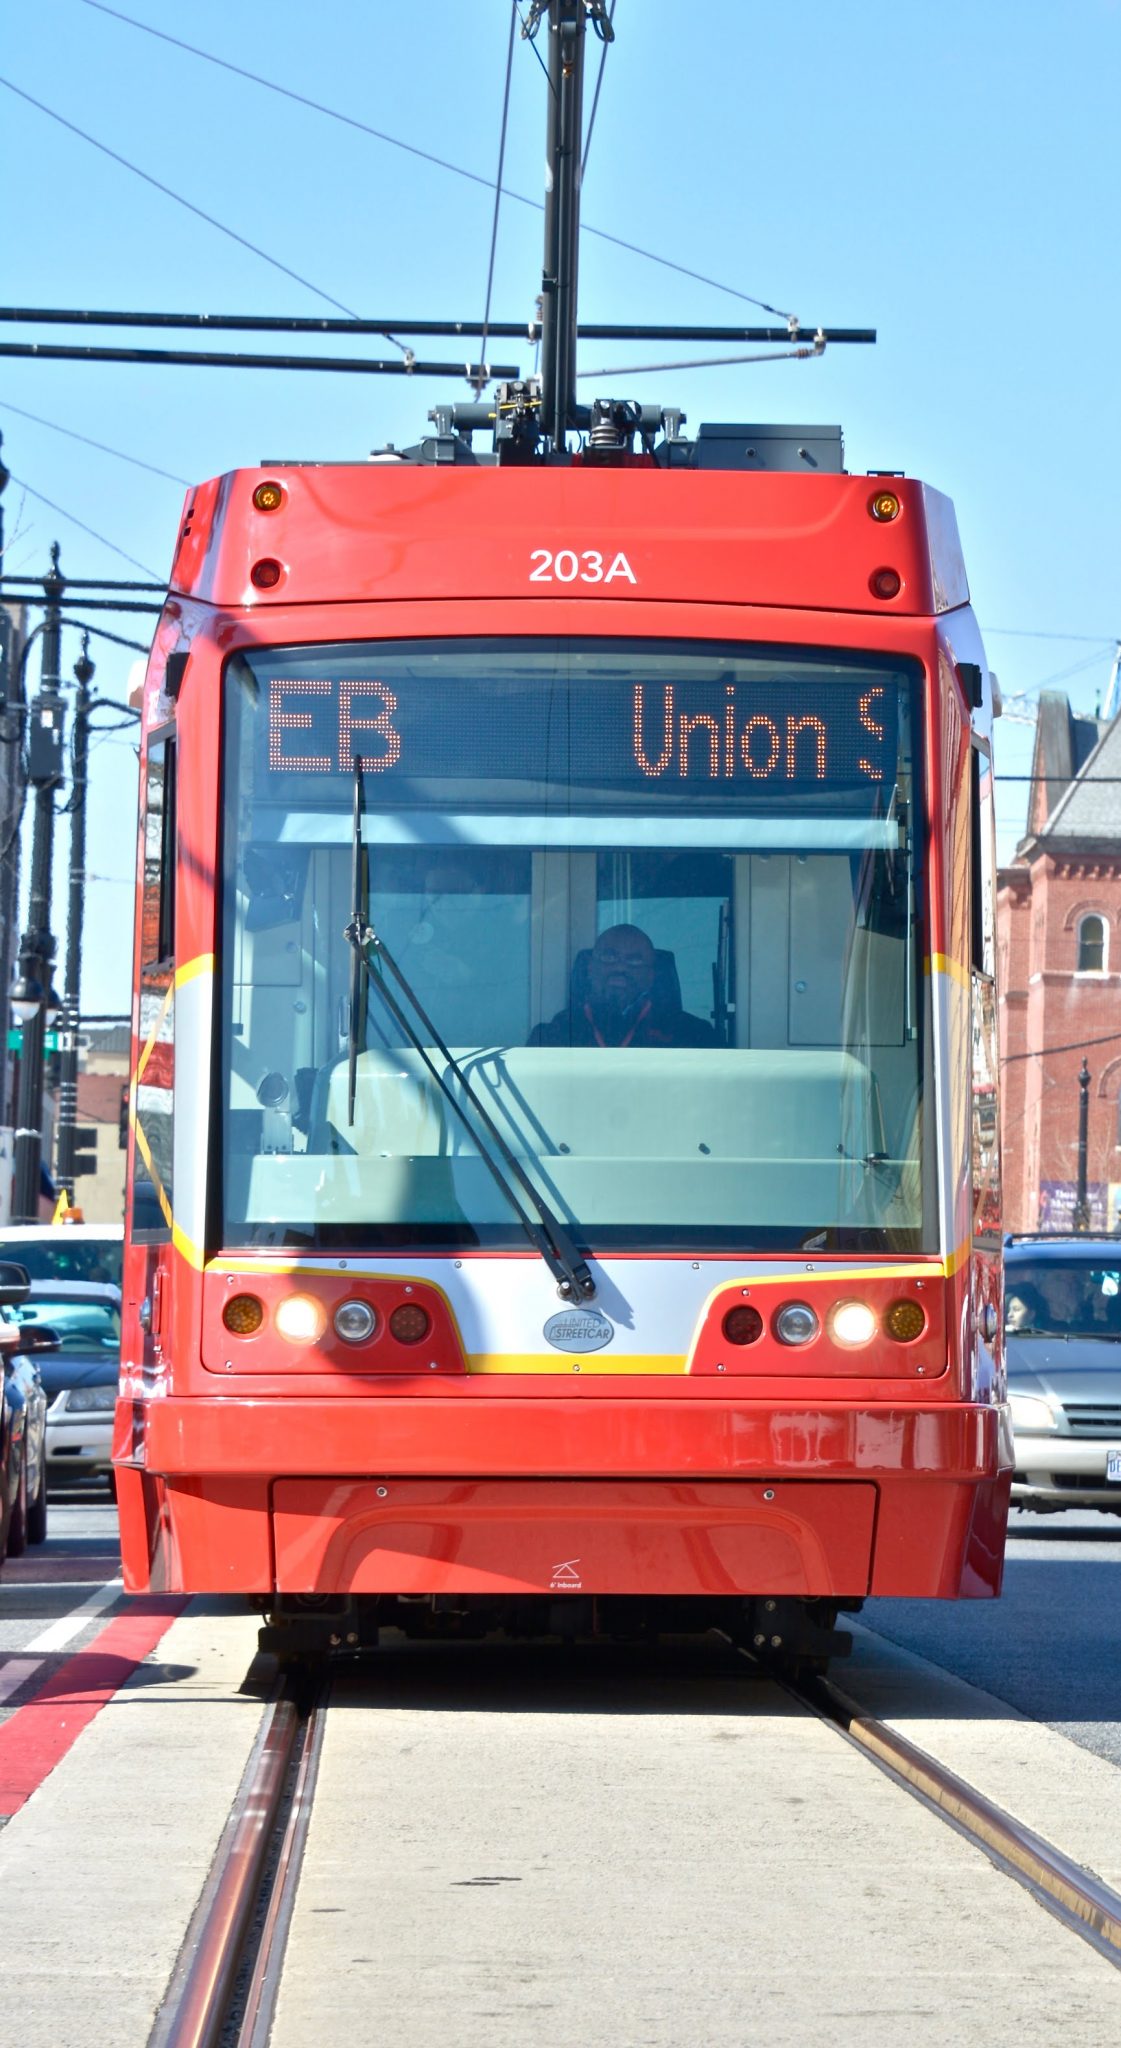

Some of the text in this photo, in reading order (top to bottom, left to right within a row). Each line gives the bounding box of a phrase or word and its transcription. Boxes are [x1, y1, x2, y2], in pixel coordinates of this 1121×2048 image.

[529, 549, 637, 584] 203A
[269, 680, 401, 772] EB
[633, 684, 827, 779] Union
[556, 1328, 610, 1339] STREETCAR
